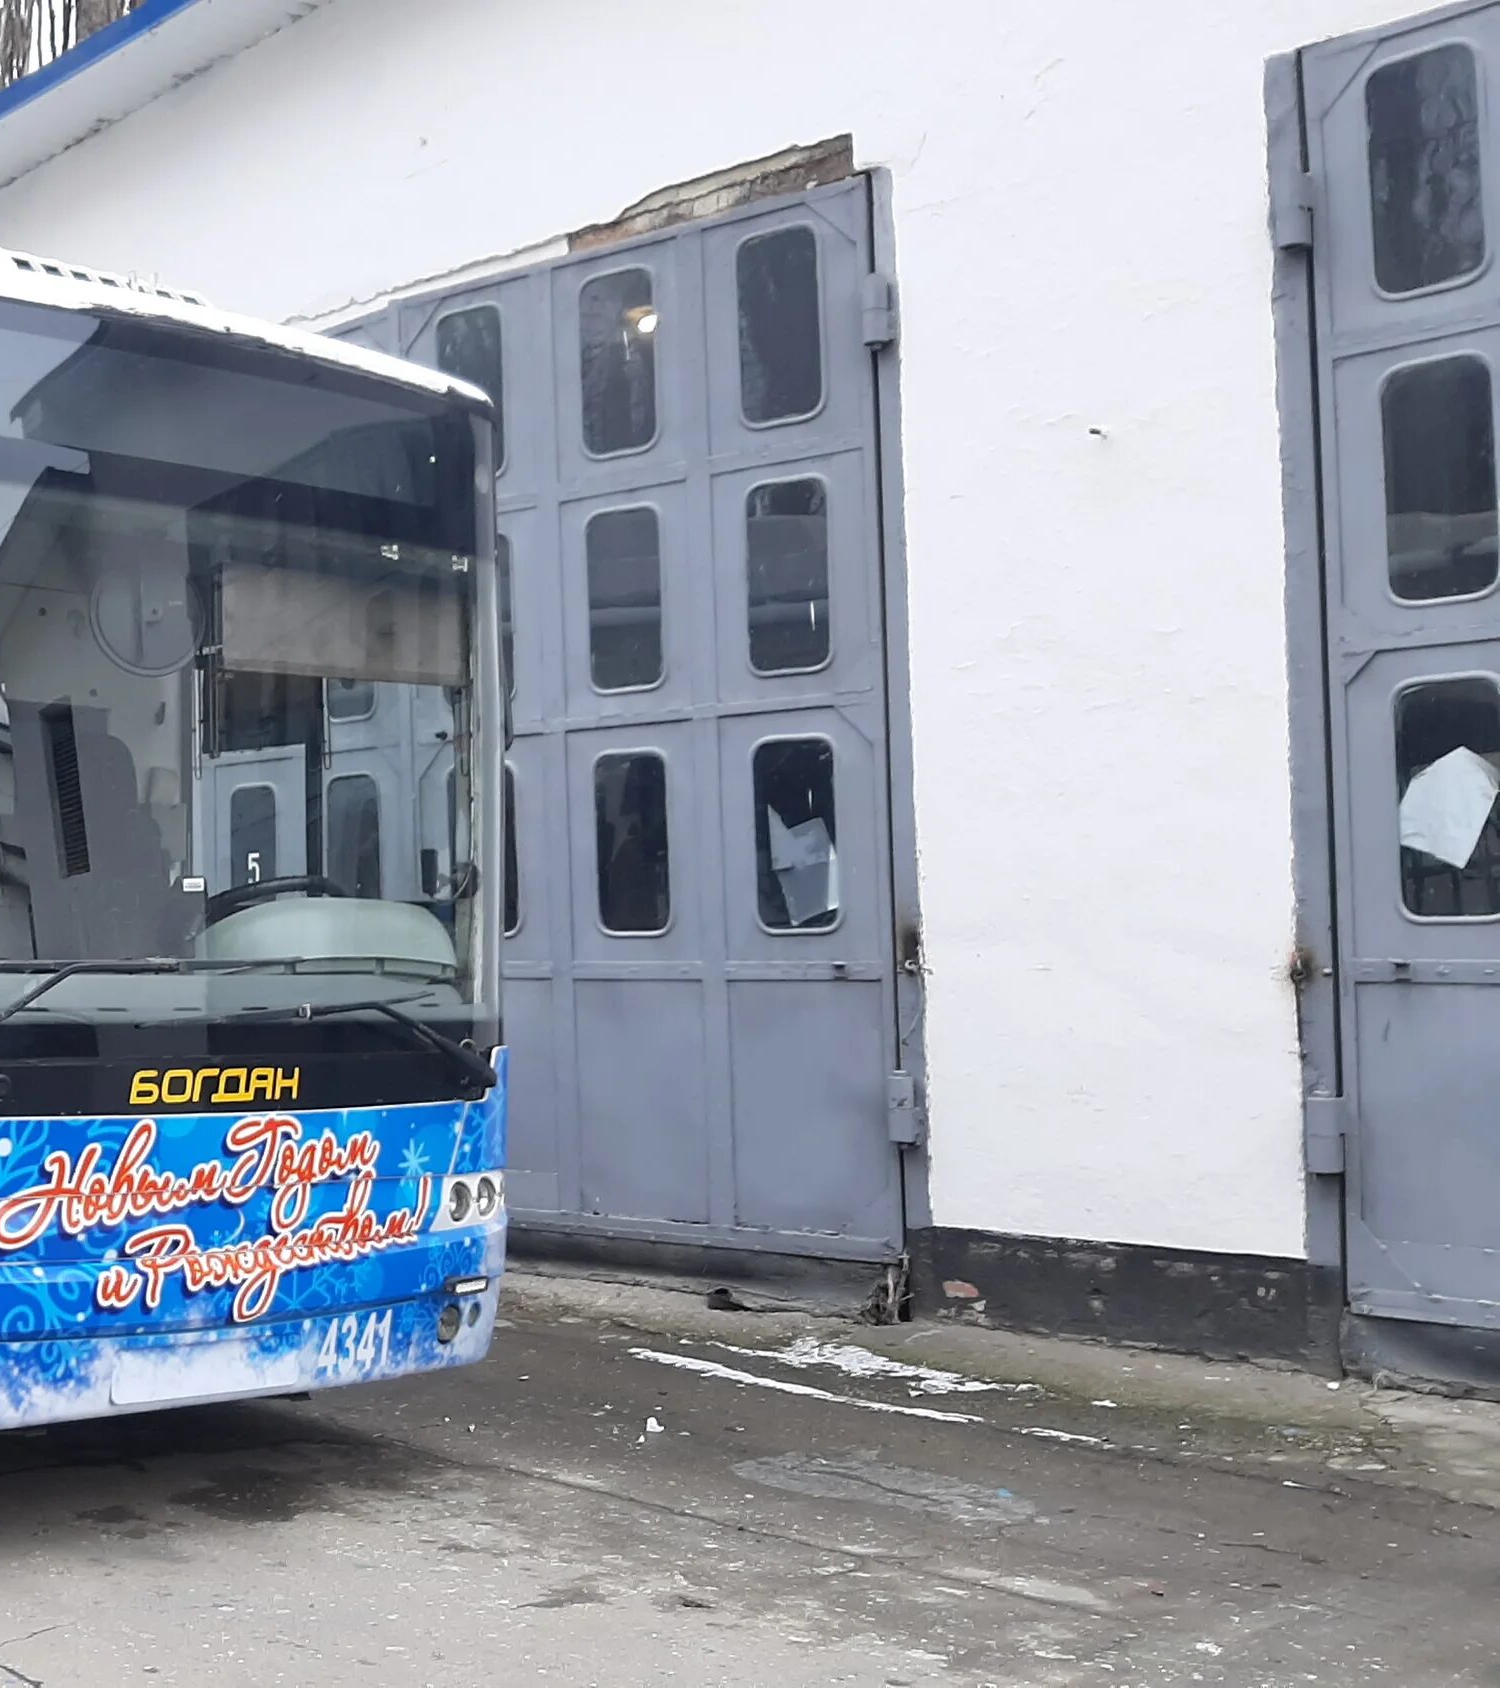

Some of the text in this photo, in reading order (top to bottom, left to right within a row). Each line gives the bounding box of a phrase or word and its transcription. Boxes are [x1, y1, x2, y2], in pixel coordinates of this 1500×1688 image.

[129, 1067, 300, 1104] БОГДАН
[227, 1114, 379, 1233] Годом
[98, 1168, 432, 1324] и Рождеством!
[318, 1309, 393, 1376] 4341
